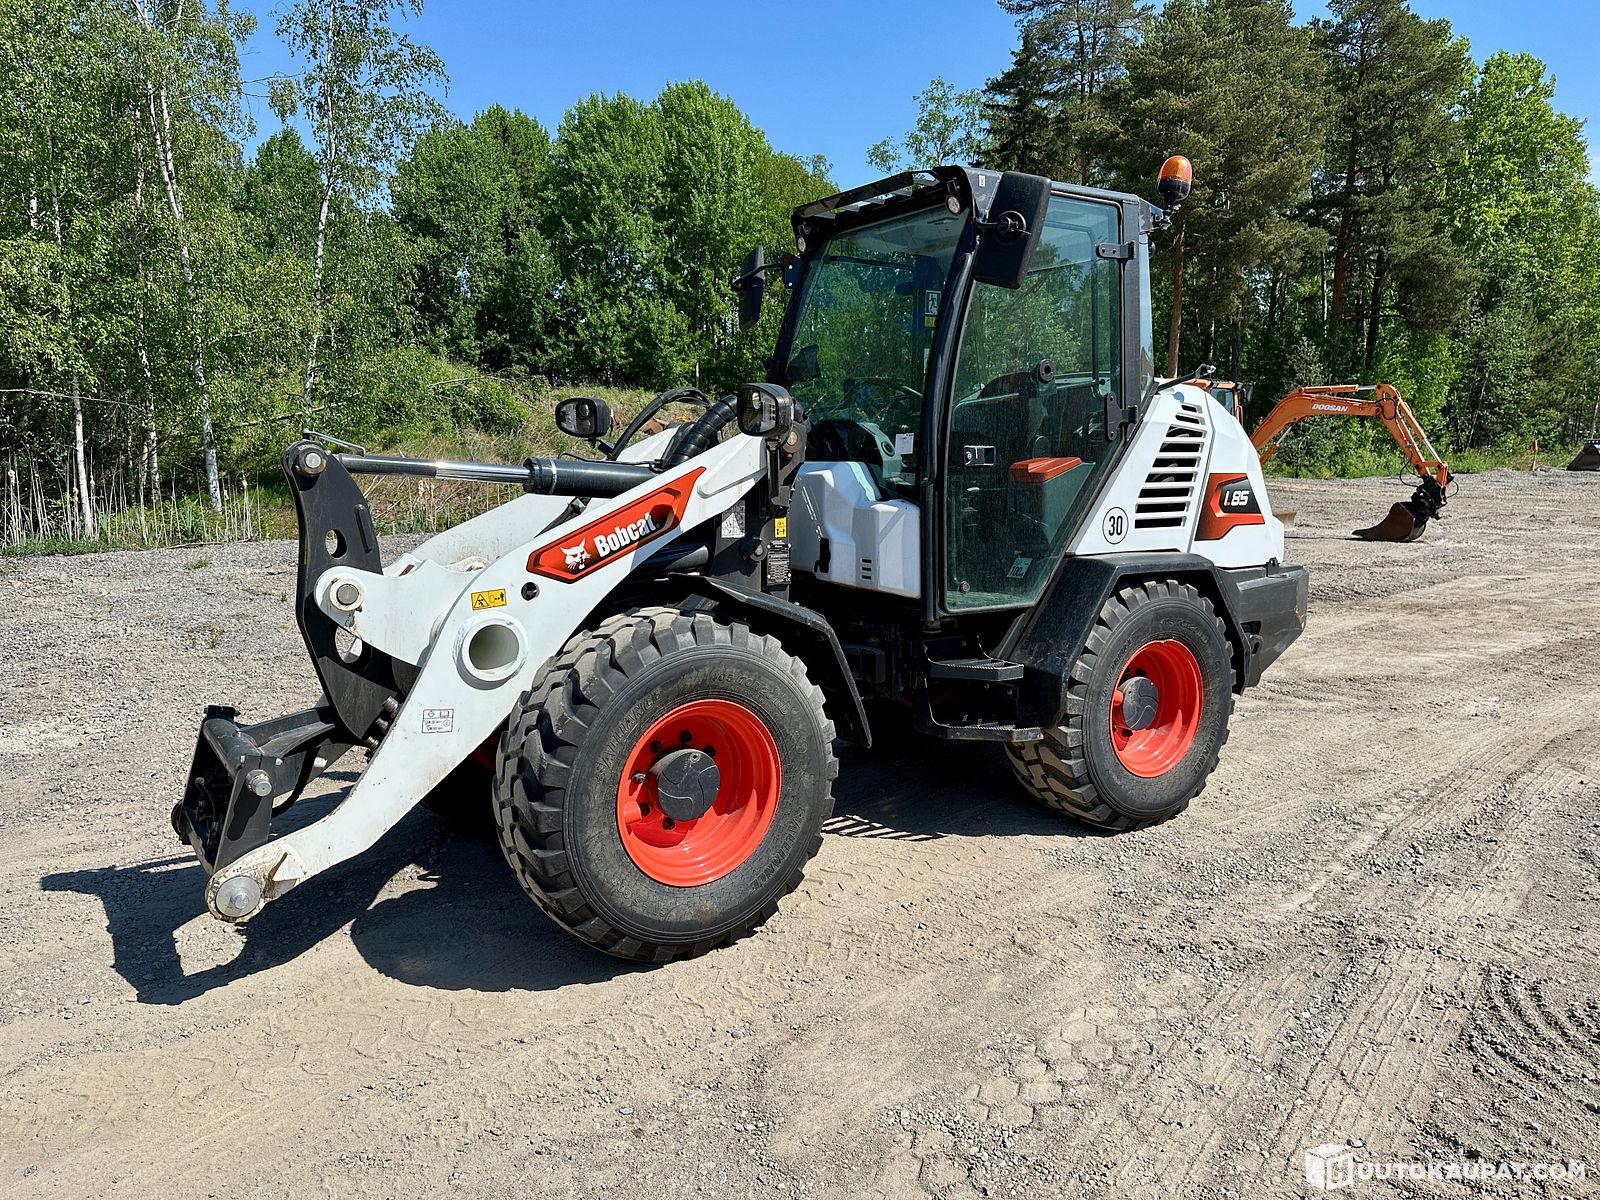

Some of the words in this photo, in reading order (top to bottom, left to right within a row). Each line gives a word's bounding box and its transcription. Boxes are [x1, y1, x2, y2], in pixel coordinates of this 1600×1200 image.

[1311, 402, 1349, 413] DOOSAN
[593, 511, 657, 558] Bobcat
[1108, 515, 1123, 536] 30
